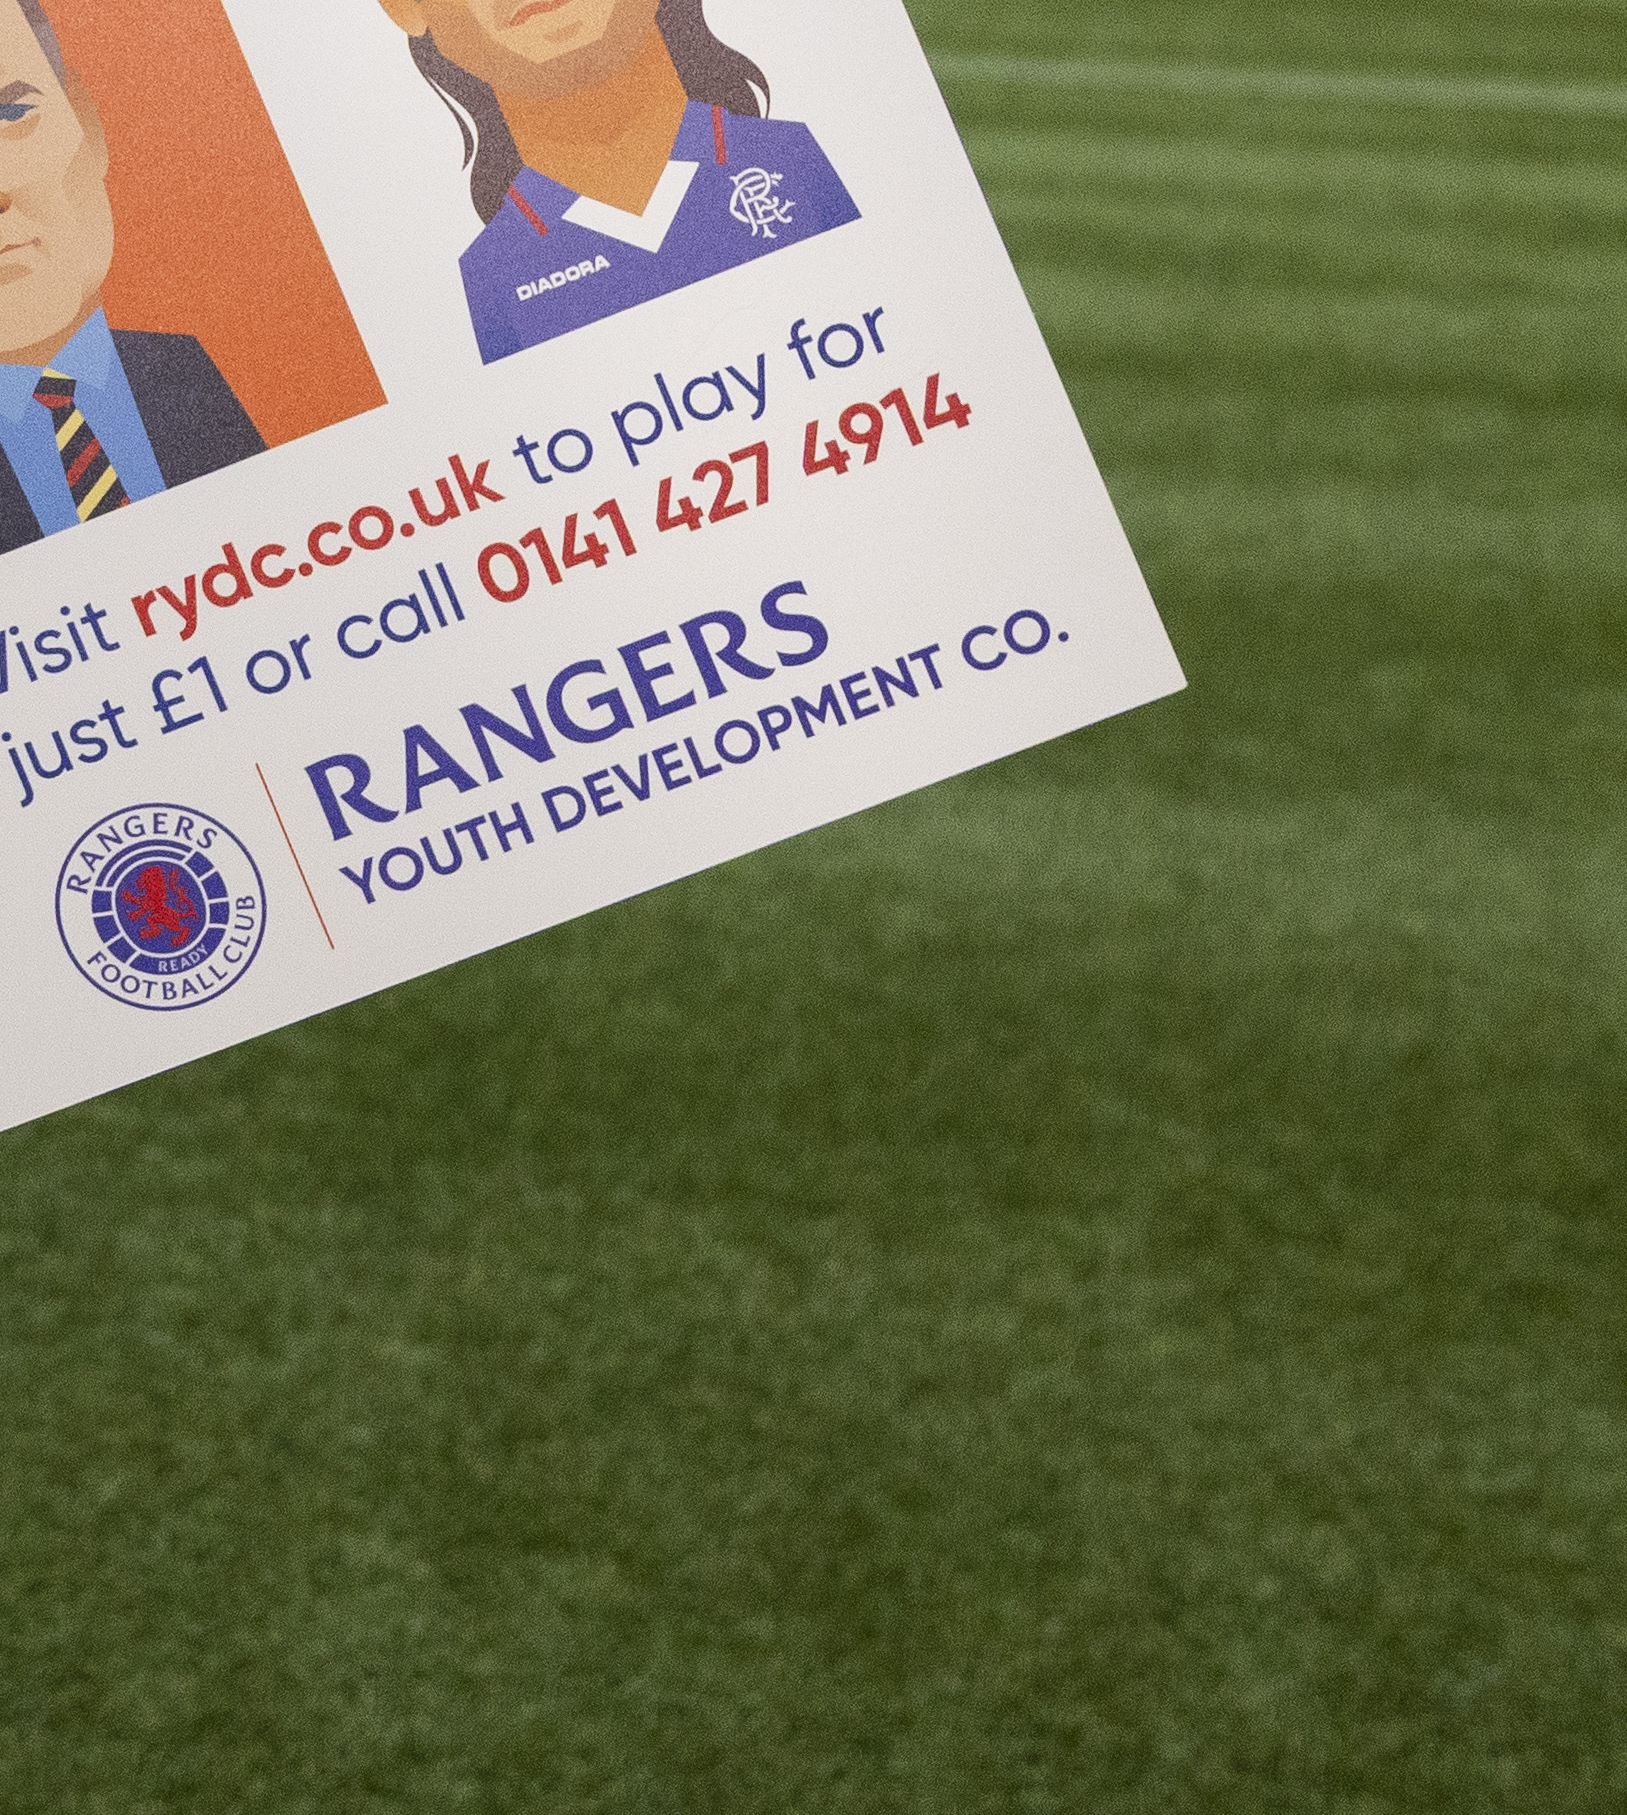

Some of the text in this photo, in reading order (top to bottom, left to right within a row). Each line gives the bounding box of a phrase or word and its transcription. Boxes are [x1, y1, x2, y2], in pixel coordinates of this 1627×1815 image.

[515, 254, 611, 302] DIADORA
[130, 454, 504, 642] rydc.co.uk
[512, 427, 595, 486] to
[610, 353, 772, 471] play
[786, 302, 887, 385] for
[0, 372, 974, 808] just £1 or call 0141 427 4914
[304, 580, 829, 841] RANGERS
[338, 607, 1070, 905] YOUTH DEVELOPMENT CO.
[67, 812, 218, 894] RANGERS
[87, 895, 256, 1001] FOOTBALL CLUB
[158, 943, 209, 973] READY
